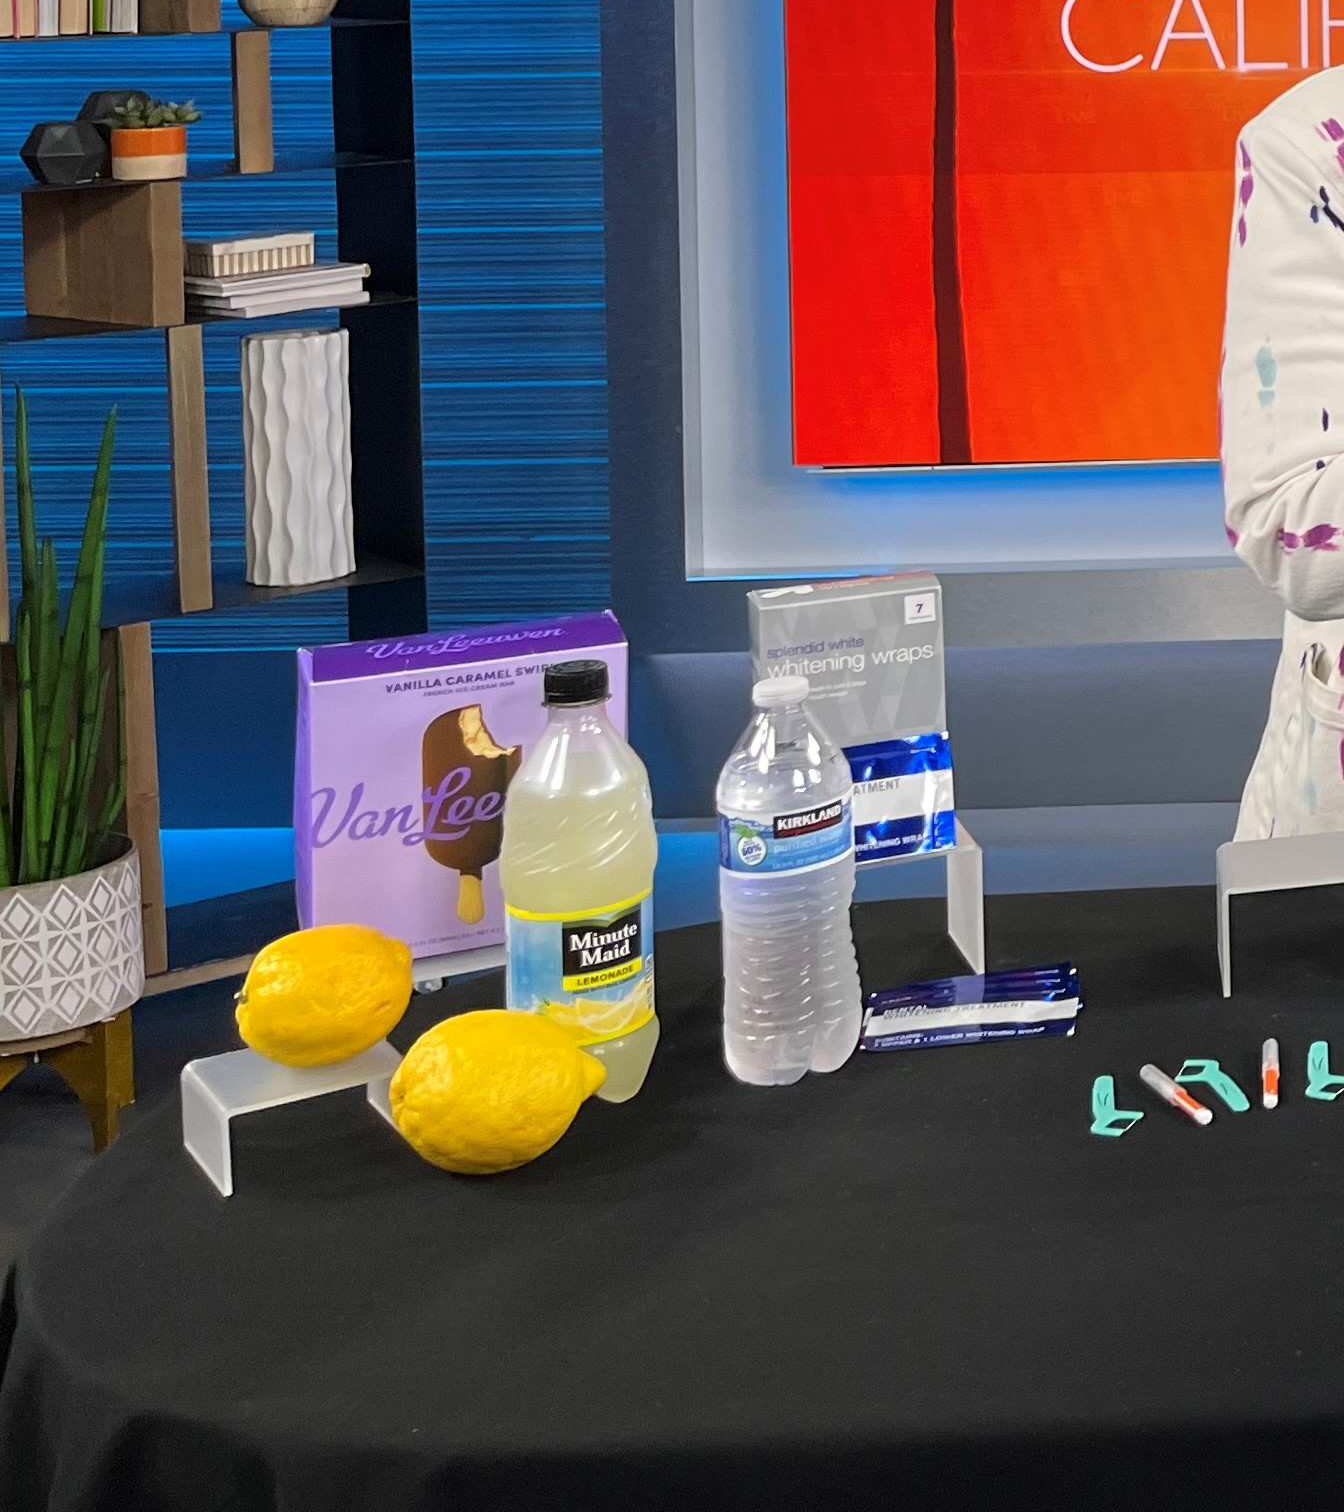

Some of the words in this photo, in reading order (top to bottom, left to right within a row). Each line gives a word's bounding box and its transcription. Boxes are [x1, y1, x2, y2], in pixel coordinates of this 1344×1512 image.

[915, 603, 924, 614] 7
[767, 640, 825, 659] splendid
[828, 636, 865, 652] white
[767, 652, 865, 678] whitening
[871, 643, 935, 665] wraps
[385, 678, 442, 694] VANILLA
[445, 668, 513, 686] CARAMEL
[777, 803, 842, 831] KIRKLAND
[569, 922, 638, 952] Minute
[579, 939, 632, 969] Maid
[576, 964, 634, 987] LEMONADE
